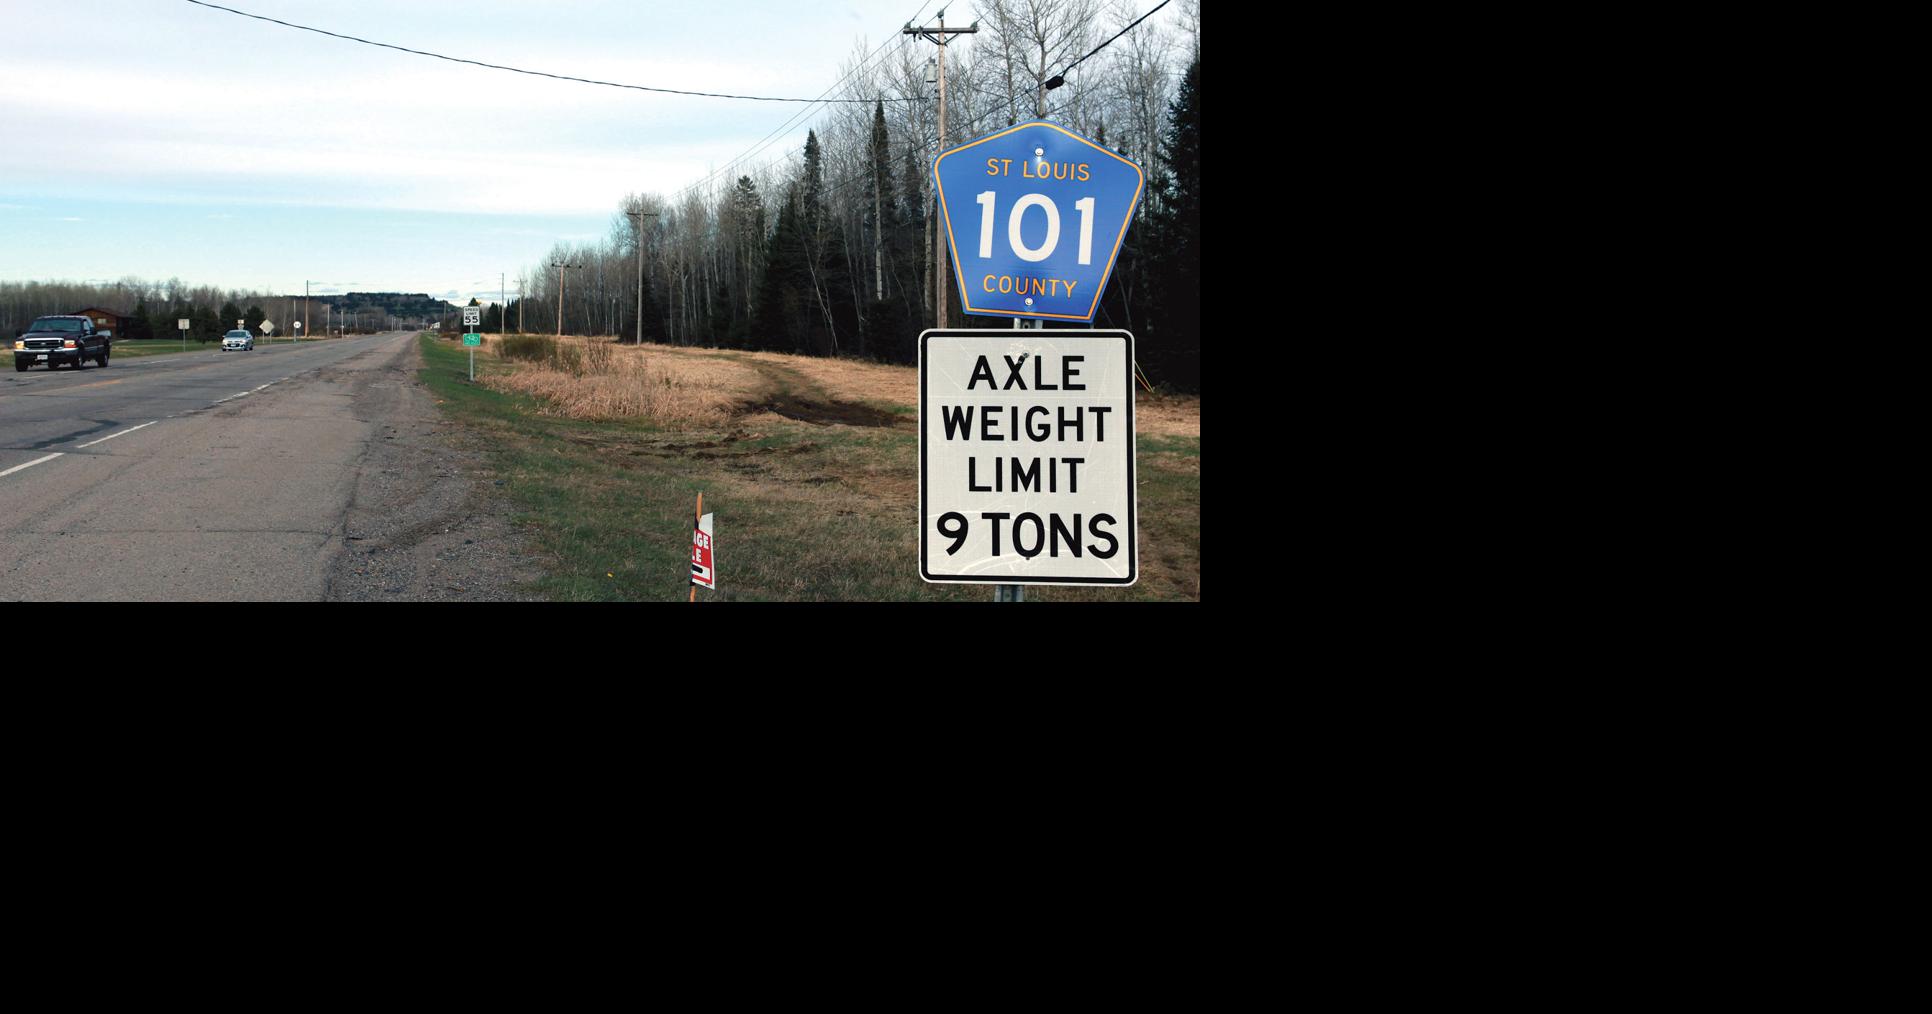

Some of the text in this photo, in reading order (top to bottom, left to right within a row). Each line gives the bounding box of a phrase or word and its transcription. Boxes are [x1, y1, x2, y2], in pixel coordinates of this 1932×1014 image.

[986, 158, 1090, 181] ST LOUIS
[976, 190, 1095, 265] 101
[983, 275, 1077, 298] COUNTY
[967, 355, 1086, 390] AXLE
[942, 405, 1112, 442] WEIGHT
[968, 456, 1085, 493] LIMIT
[936, 511, 1119, 559] 9 TONS
